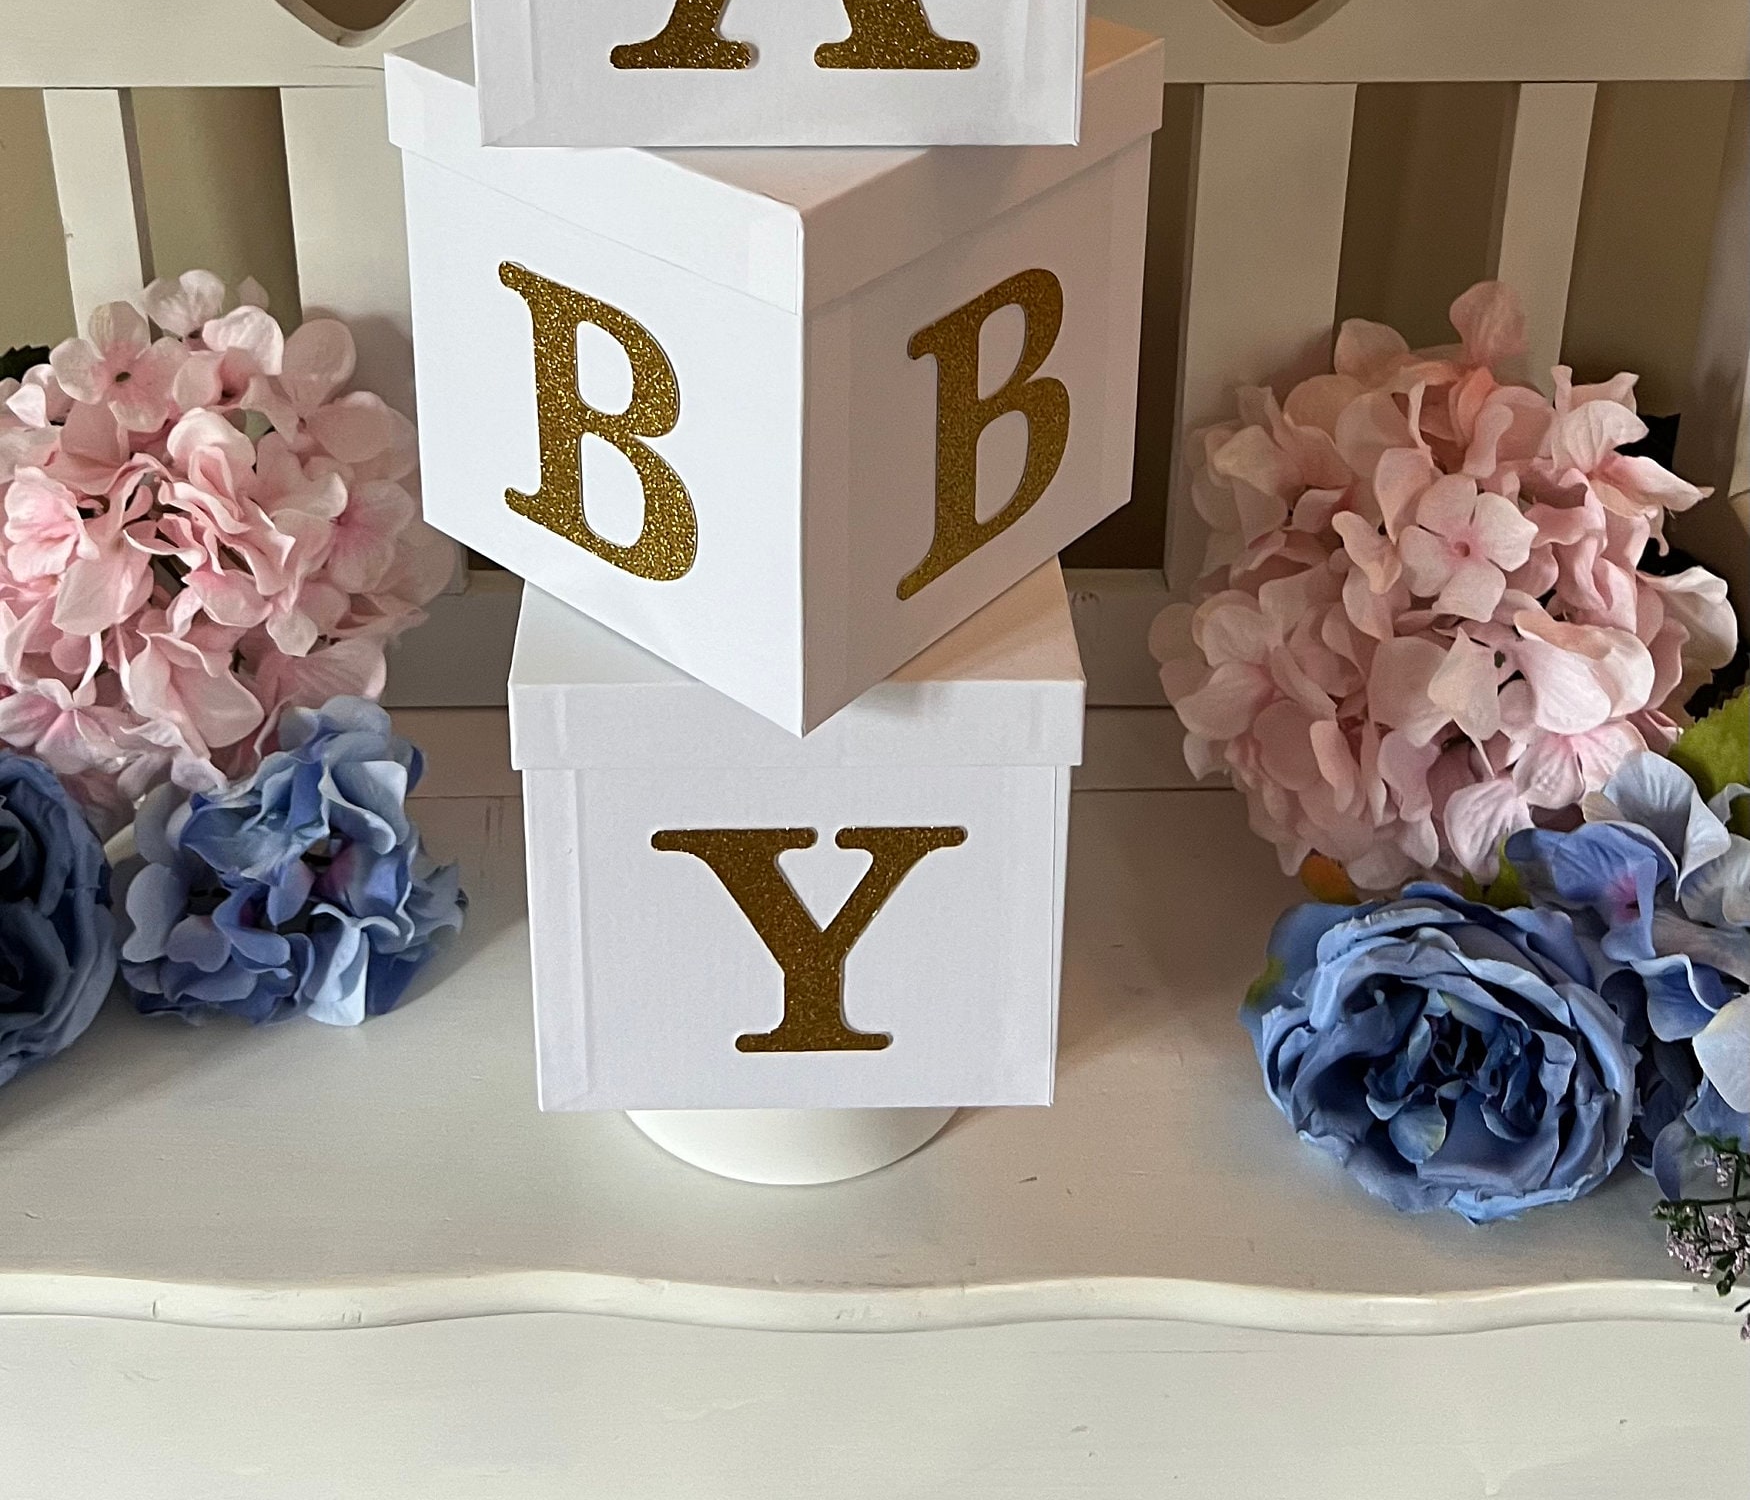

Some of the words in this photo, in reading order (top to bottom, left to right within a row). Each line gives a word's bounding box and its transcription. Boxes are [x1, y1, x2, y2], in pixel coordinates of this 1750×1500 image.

[499, 262, 697, 581] B
[897, 269, 1070, 601] B
[652, 827, 967, 1052] Y
